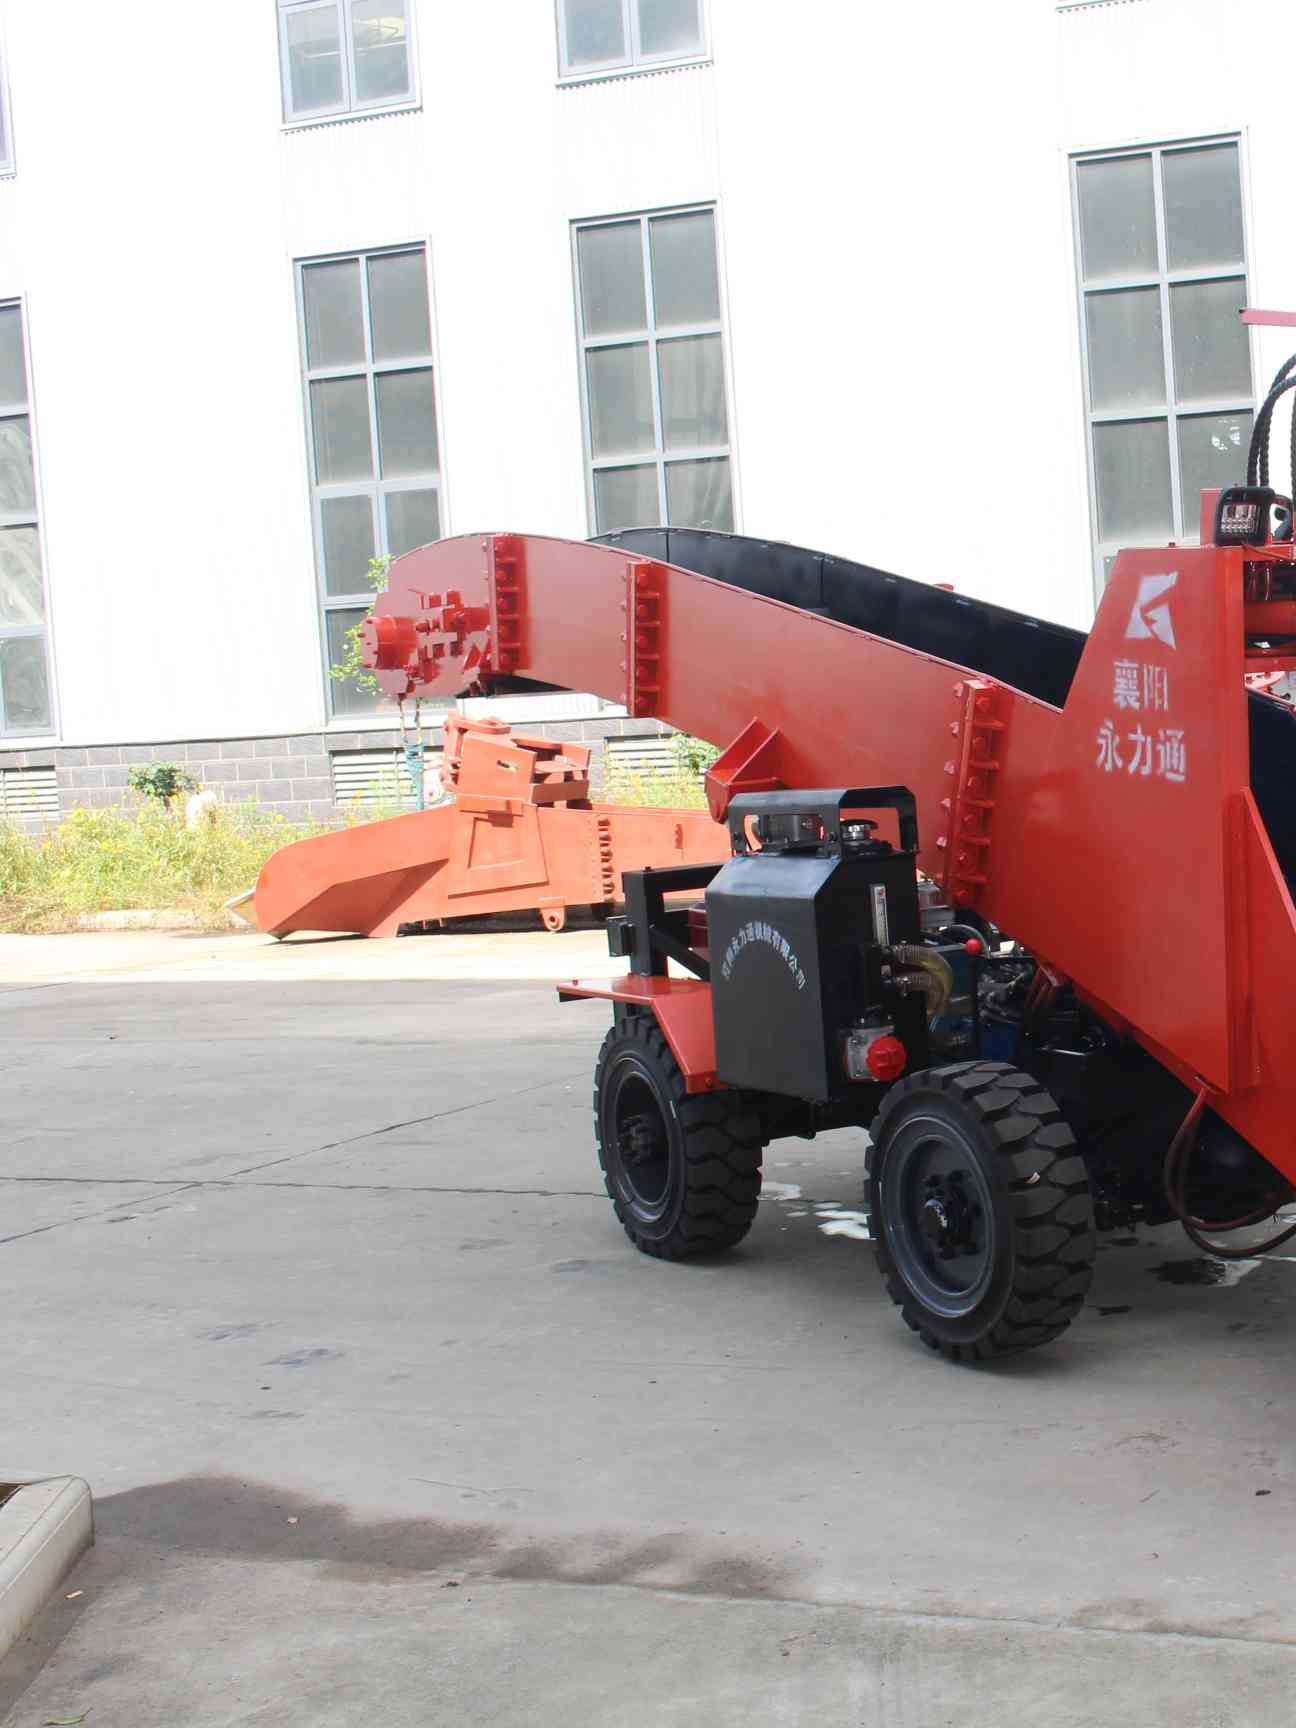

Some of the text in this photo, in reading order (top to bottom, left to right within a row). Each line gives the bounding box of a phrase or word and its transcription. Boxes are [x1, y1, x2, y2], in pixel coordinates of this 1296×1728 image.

[1113, 658, 1169, 712] 襄阳
[1096, 719, 1186, 782] 永力通
